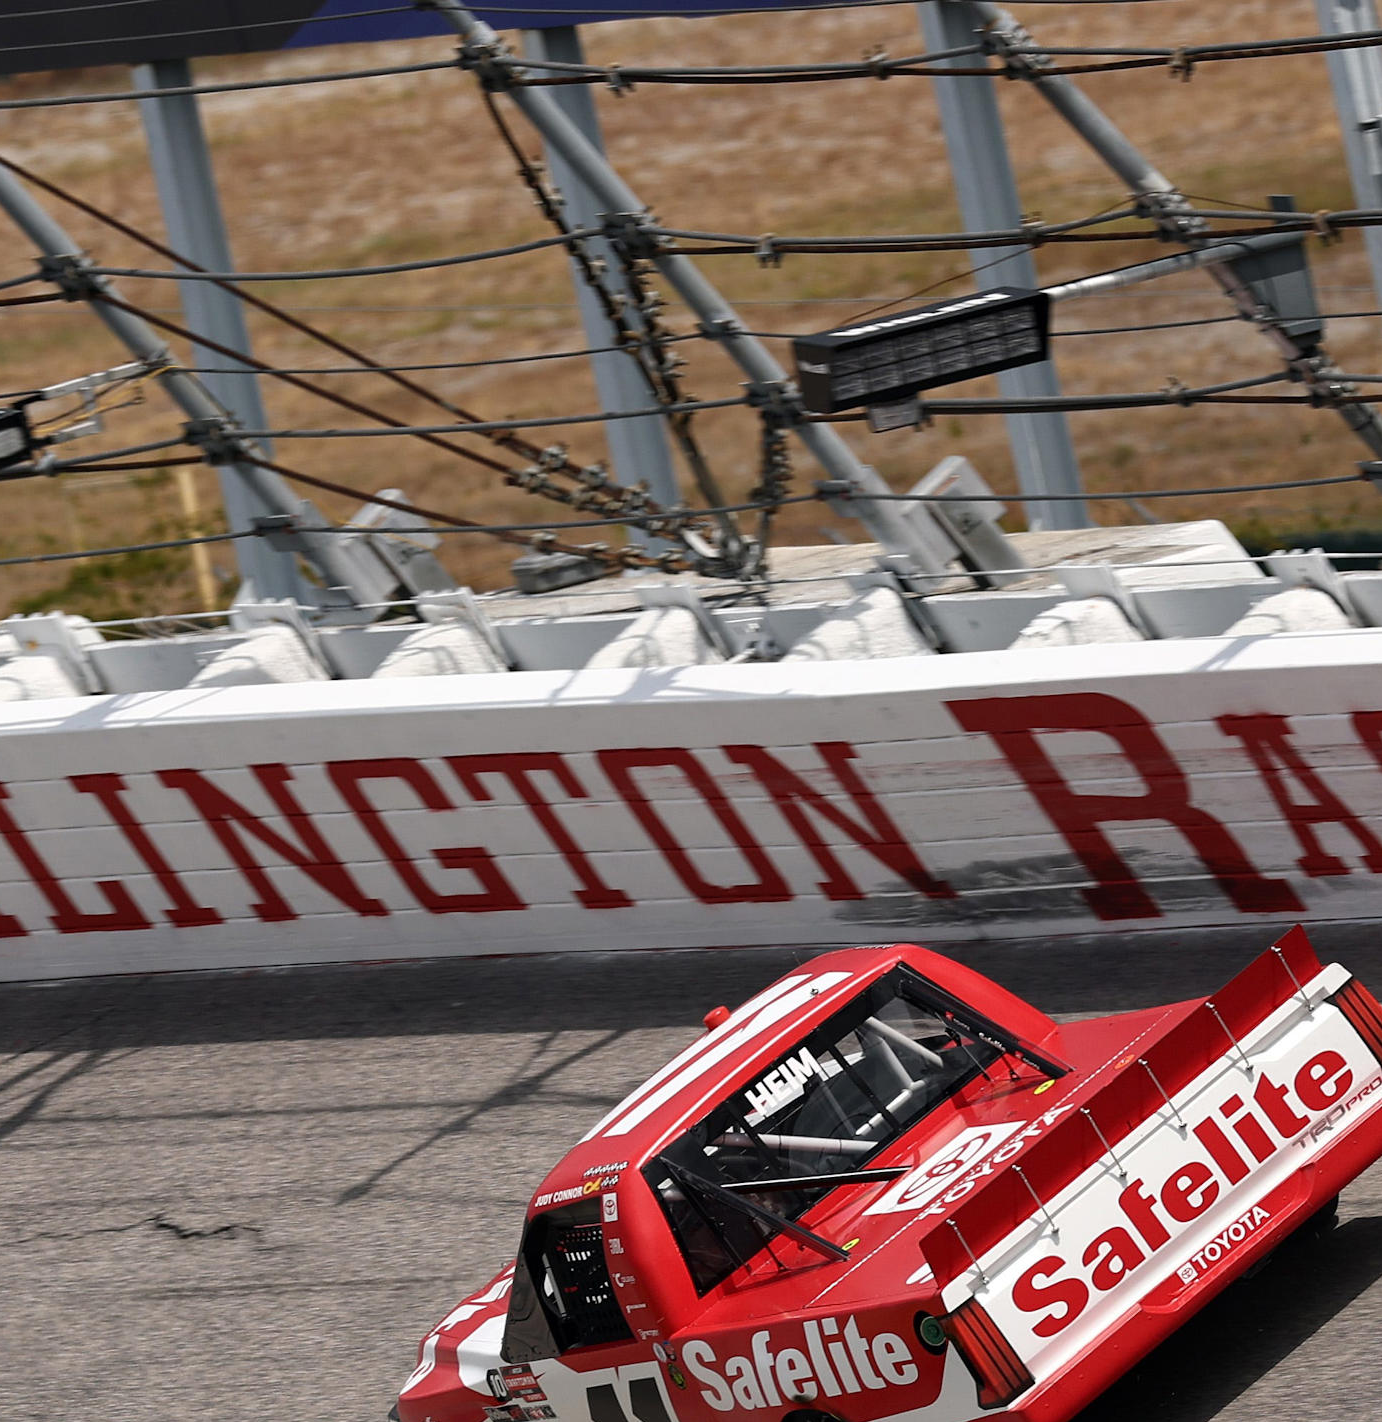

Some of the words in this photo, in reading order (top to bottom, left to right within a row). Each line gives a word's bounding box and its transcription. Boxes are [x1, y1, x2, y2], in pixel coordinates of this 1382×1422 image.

[744, 1047, 826, 1118] HEIM
[1292, 1104, 1346, 1149] TRD
[918, 1103, 1075, 1220] TOYOTA
[1011, 1050, 1354, 1338] Safelite
[535, 1194, 553, 1208] JUDY
[553, 1186, 583, 1203] CONNOR
[1191, 1205, 1271, 1269] TOYOTA
[490, 1374, 507, 1398] 10
[681, 1313, 919, 1412] Safelite
